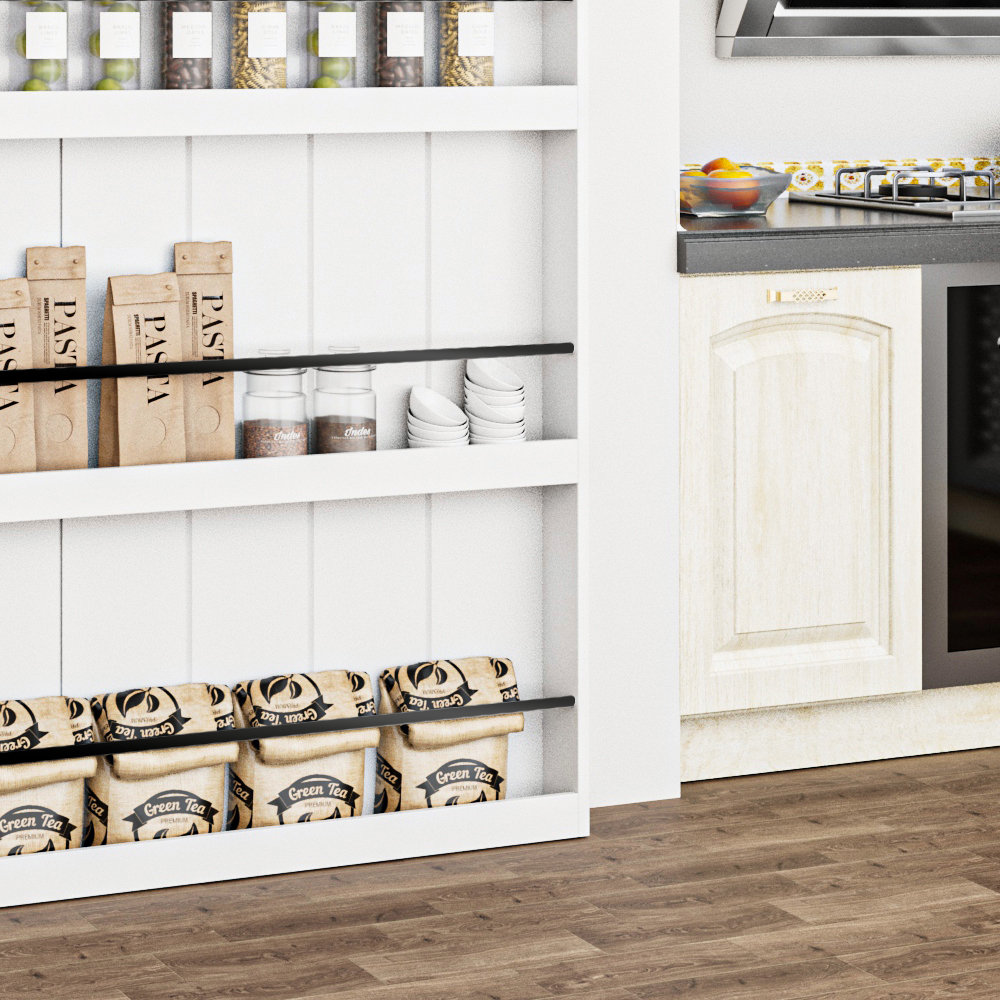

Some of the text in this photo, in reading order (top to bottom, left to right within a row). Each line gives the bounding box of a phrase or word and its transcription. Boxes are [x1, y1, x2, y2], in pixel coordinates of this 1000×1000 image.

[408, 693, 464, 711] Green Tea
[260, 708, 318, 725] Green Tea
[115, 722, 175, 740] Green Tea
[381, 764, 398, 784] Tea
[436, 766, 493, 785] Green Tea
[233, 779, 250, 800] Tea
[288, 782, 348, 801] Green Tea
[88, 795, 105, 816] Tea
[144, 798, 206, 817] Green Tea
[41, 813, 63, 830] Tea
